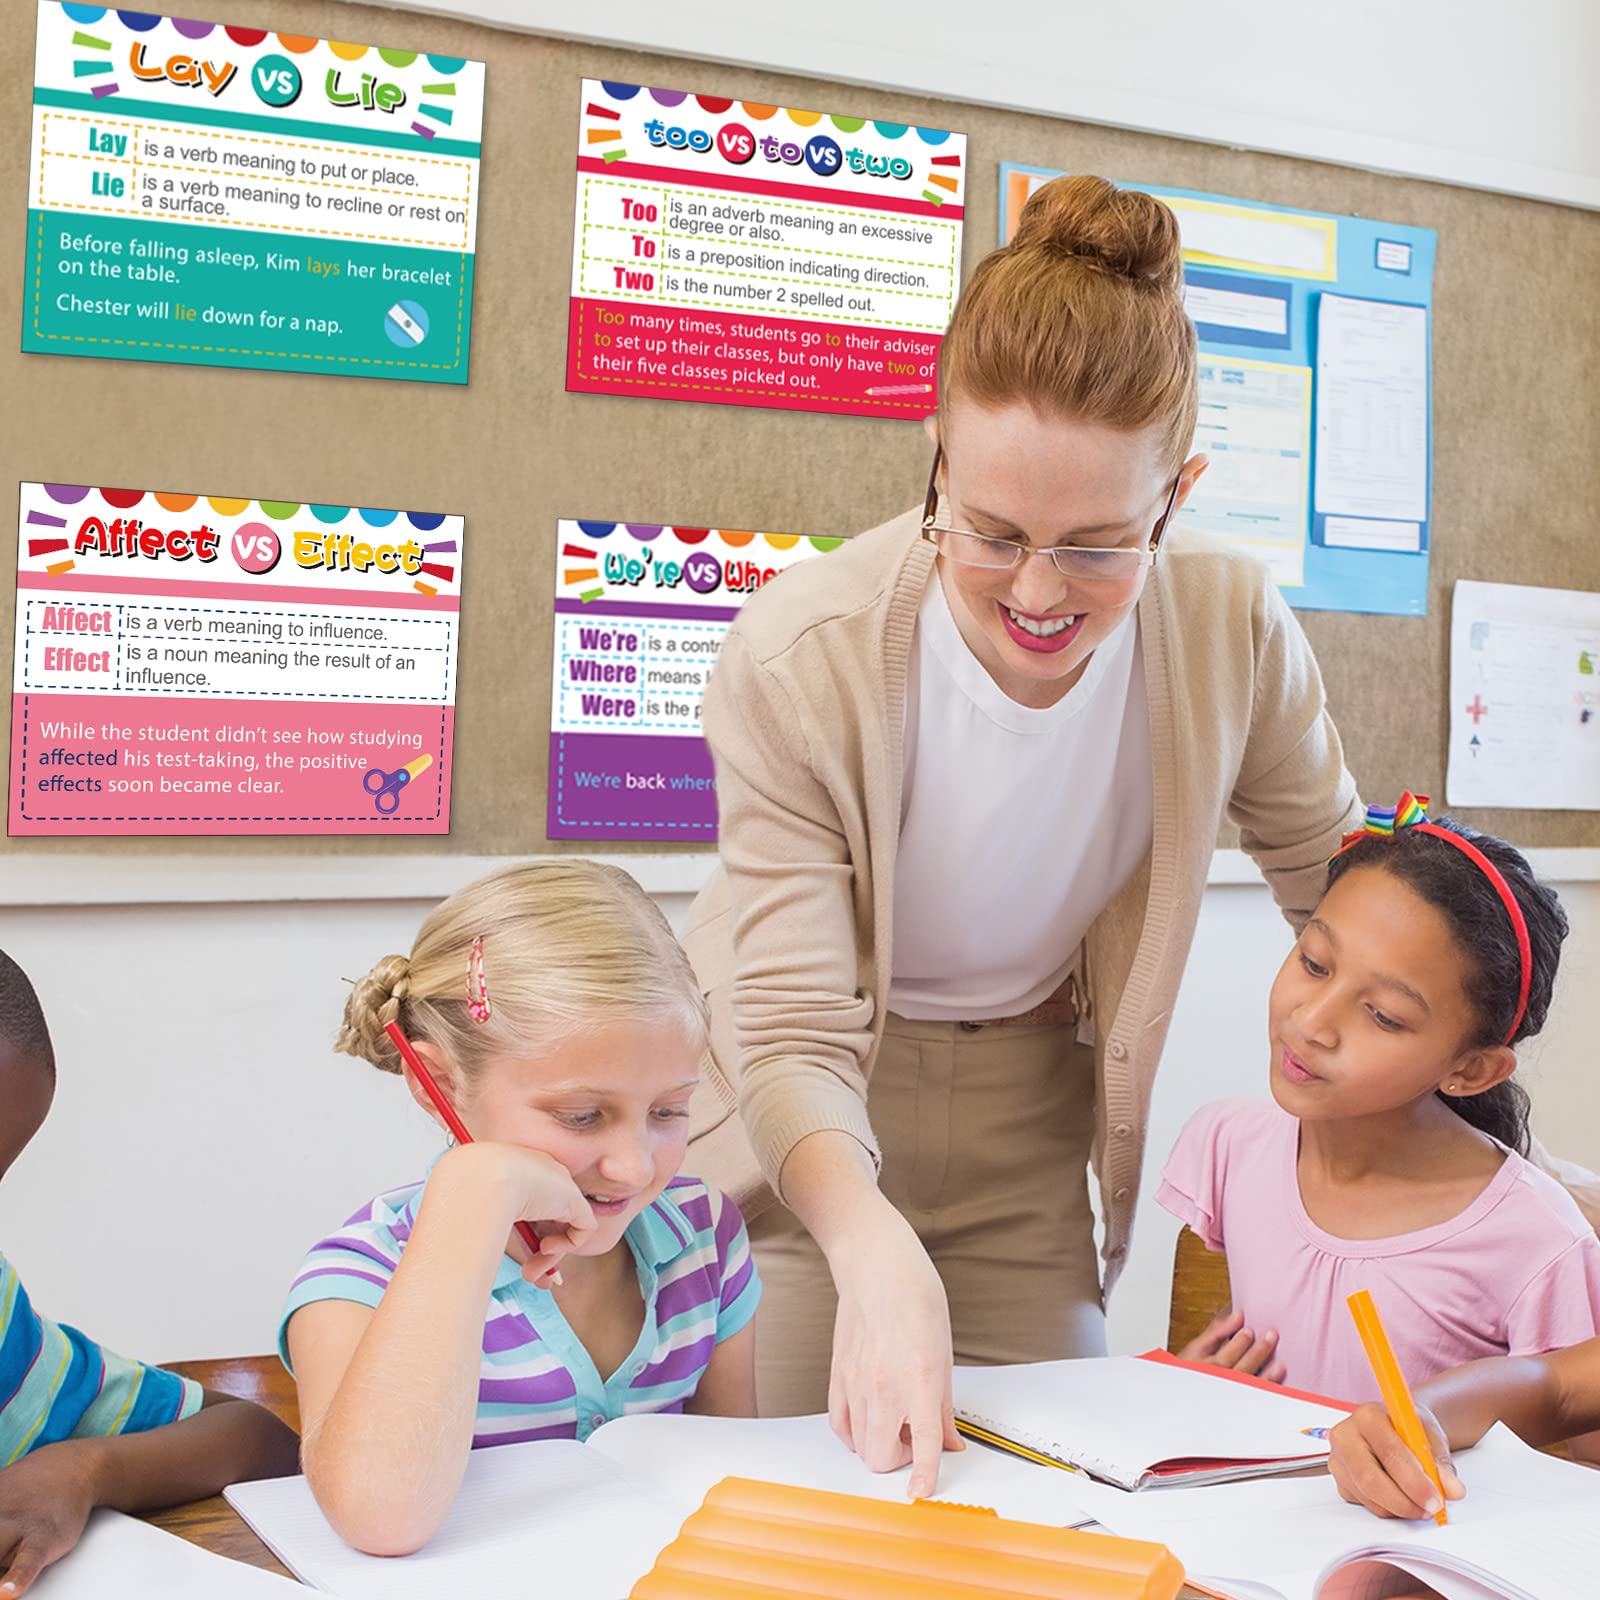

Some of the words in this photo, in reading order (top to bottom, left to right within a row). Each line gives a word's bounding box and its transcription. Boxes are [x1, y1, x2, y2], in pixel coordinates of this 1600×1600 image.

[129, 41, 238, 98] Lay
[325, 68, 407, 114] Lie
[89, 127, 127, 161] Lay
[644, 119, 714, 154] too
[760, 136, 804, 165] to
[845, 147, 913, 181] two
[144, 139, 159, 157] is
[163, 146, 174, 158] a
[180, 147, 218, 163] verb
[223, 152, 296, 176] meaning
[301, 159, 316, 175] to
[321, 163, 347, 180] put
[351, 168, 368, 180] or
[372, 168, 418, 187] place.
[92, 171, 124, 198] Lie
[143, 173, 157, 190] is
[163, 179, 174, 192] a
[180, 181, 219, 197] verb
[224, 187, 301, 209] meaning
[306, 192, 322, 208] to
[327, 196, 383, 215] recline
[388, 204, 405, 216] or
[410, 206, 441, 221] rest
[445, 208, 466, 223] on
[142, 195, 153, 208] a
[160, 196, 229, 216] surface.
[621, 198, 657, 222] Too
[669, 215, 724, 239] degree
[729, 224, 745, 236] or
[749, 225, 784, 242] also.
[670, 198, 683, 213] is
[688, 204, 707, 216] an
[712, 205, 765, 223] adverb
[770, 213, 834, 235] meaning
[838, 222, 857, 235] an
[861, 221, 933, 244] excessive
[60, 232, 122, 255] Before
[129, 239, 188, 265] falling
[195, 247, 259, 270] asleep,
[266, 253, 300, 271] Kim
[307, 256, 340, 278] lays
[347, 260, 376, 278] her
[382, 263, 451, 286] bracelet
[632, 235, 656, 258] To
[58, 260, 83, 275] on
[90, 259, 121, 278] the
[127, 264, 179, 283] table.
[613, 267, 654, 291] Two
[668, 244, 680, 260] is
[685, 250, 695, 261] a
[700, 251, 785, 272] preposition
[789, 258, 860, 281] indicating
[864, 267, 929, 288] direction.
[666, 275, 679, 291] is
[684, 278, 708, 294] the
[713, 284, 772, 300] number
[776, 287, 786, 302] 2
[791, 292, 843, 308] spelled
[848, 298, 875, 312] out.
[56, 293, 131, 315] Chester
[136, 302, 169, 319] will
[175, 304, 197, 321] lie
[202, 306, 254, 326] down
[260, 310, 285, 328] for
[290, 317, 299, 330] a
[306, 319, 343, 336] nap.
[595, 307, 625, 325] Too
[630, 315, 674, 333] many
[679, 317, 725, 337] times,
[731, 324, 796, 342] students
[801, 332, 821, 347] go
[825, 333, 841, 346] to
[845, 333, 880, 350] their
[883, 338, 936, 355] adviser
[594, 332, 611, 347] to
[616, 336, 640, 350] set
[645, 339, 667, 355] up
[672, 338, 710, 356] their
[714, 343, 773, 364] classes,
[778, 348, 805, 365] but
[809, 353, 843, 372] only
[848, 354, 883, 372] have
[888, 360, 916, 376] two
[919, 362, 935, 377] of
[593, 353, 633, 371] their
[638, 357, 667, 375] five
[671, 361, 727, 380] classes
[733, 368, 785, 385] picked
[790, 375, 820, 388] out.
[74, 516, 221, 563] Affect
[292, 531, 425, 576] Effect
[604, 546, 683, 587] We're
[42, 606, 112, 632] Affect
[126, 613, 141, 629] is
[146, 618, 157, 630] a
[164, 616, 202, 632] verb
[208, 620, 283, 640] meaning
[288, 622, 304, 637] to
[309, 622, 387, 640] influence.
[579, 628, 638, 652] We're
[648, 635, 662, 651] is
[666, 640, 676, 652] a
[44, 647, 110, 672] Effect
[127, 643, 141, 660] is
[147, 648, 158, 660] a
[164, 649, 208, 662] noun
[214, 649, 288, 669] meaning
[294, 650, 320, 667] the
[325, 653, 371, 669] result
[375, 654, 392, 669] of
[395, 658, 415, 670] an
[126, 667, 210, 686] influence.
[569, 659, 637, 683] Where
[647, 671, 701, 685] means
[581, 694, 636, 718] Were
[646, 699, 660, 716] is
[665, 700, 690, 717] the
[40, 722, 95, 740] While
[101, 723, 132, 740] the
[138, 724, 210, 742] student
[215, 725, 267, 743] didn't
[273, 731, 302, 743] see
[307, 728, 344, 744] how
[349, 729, 422, 749] studying
[39, 748, 117, 766] affected
[124, 749, 150, 767] his
[156, 751, 259, 772] test-taking,
[265, 752, 294, 768] the
[300, 754, 367, 772] positive
[38, 775, 102, 792] effects
[108, 780, 153, 792] soon
[160, 776, 232, 793] became
[238, 777, 283, 793] clear.
[574, 772, 621, 788] We're
[626, 772, 665, 789] back
